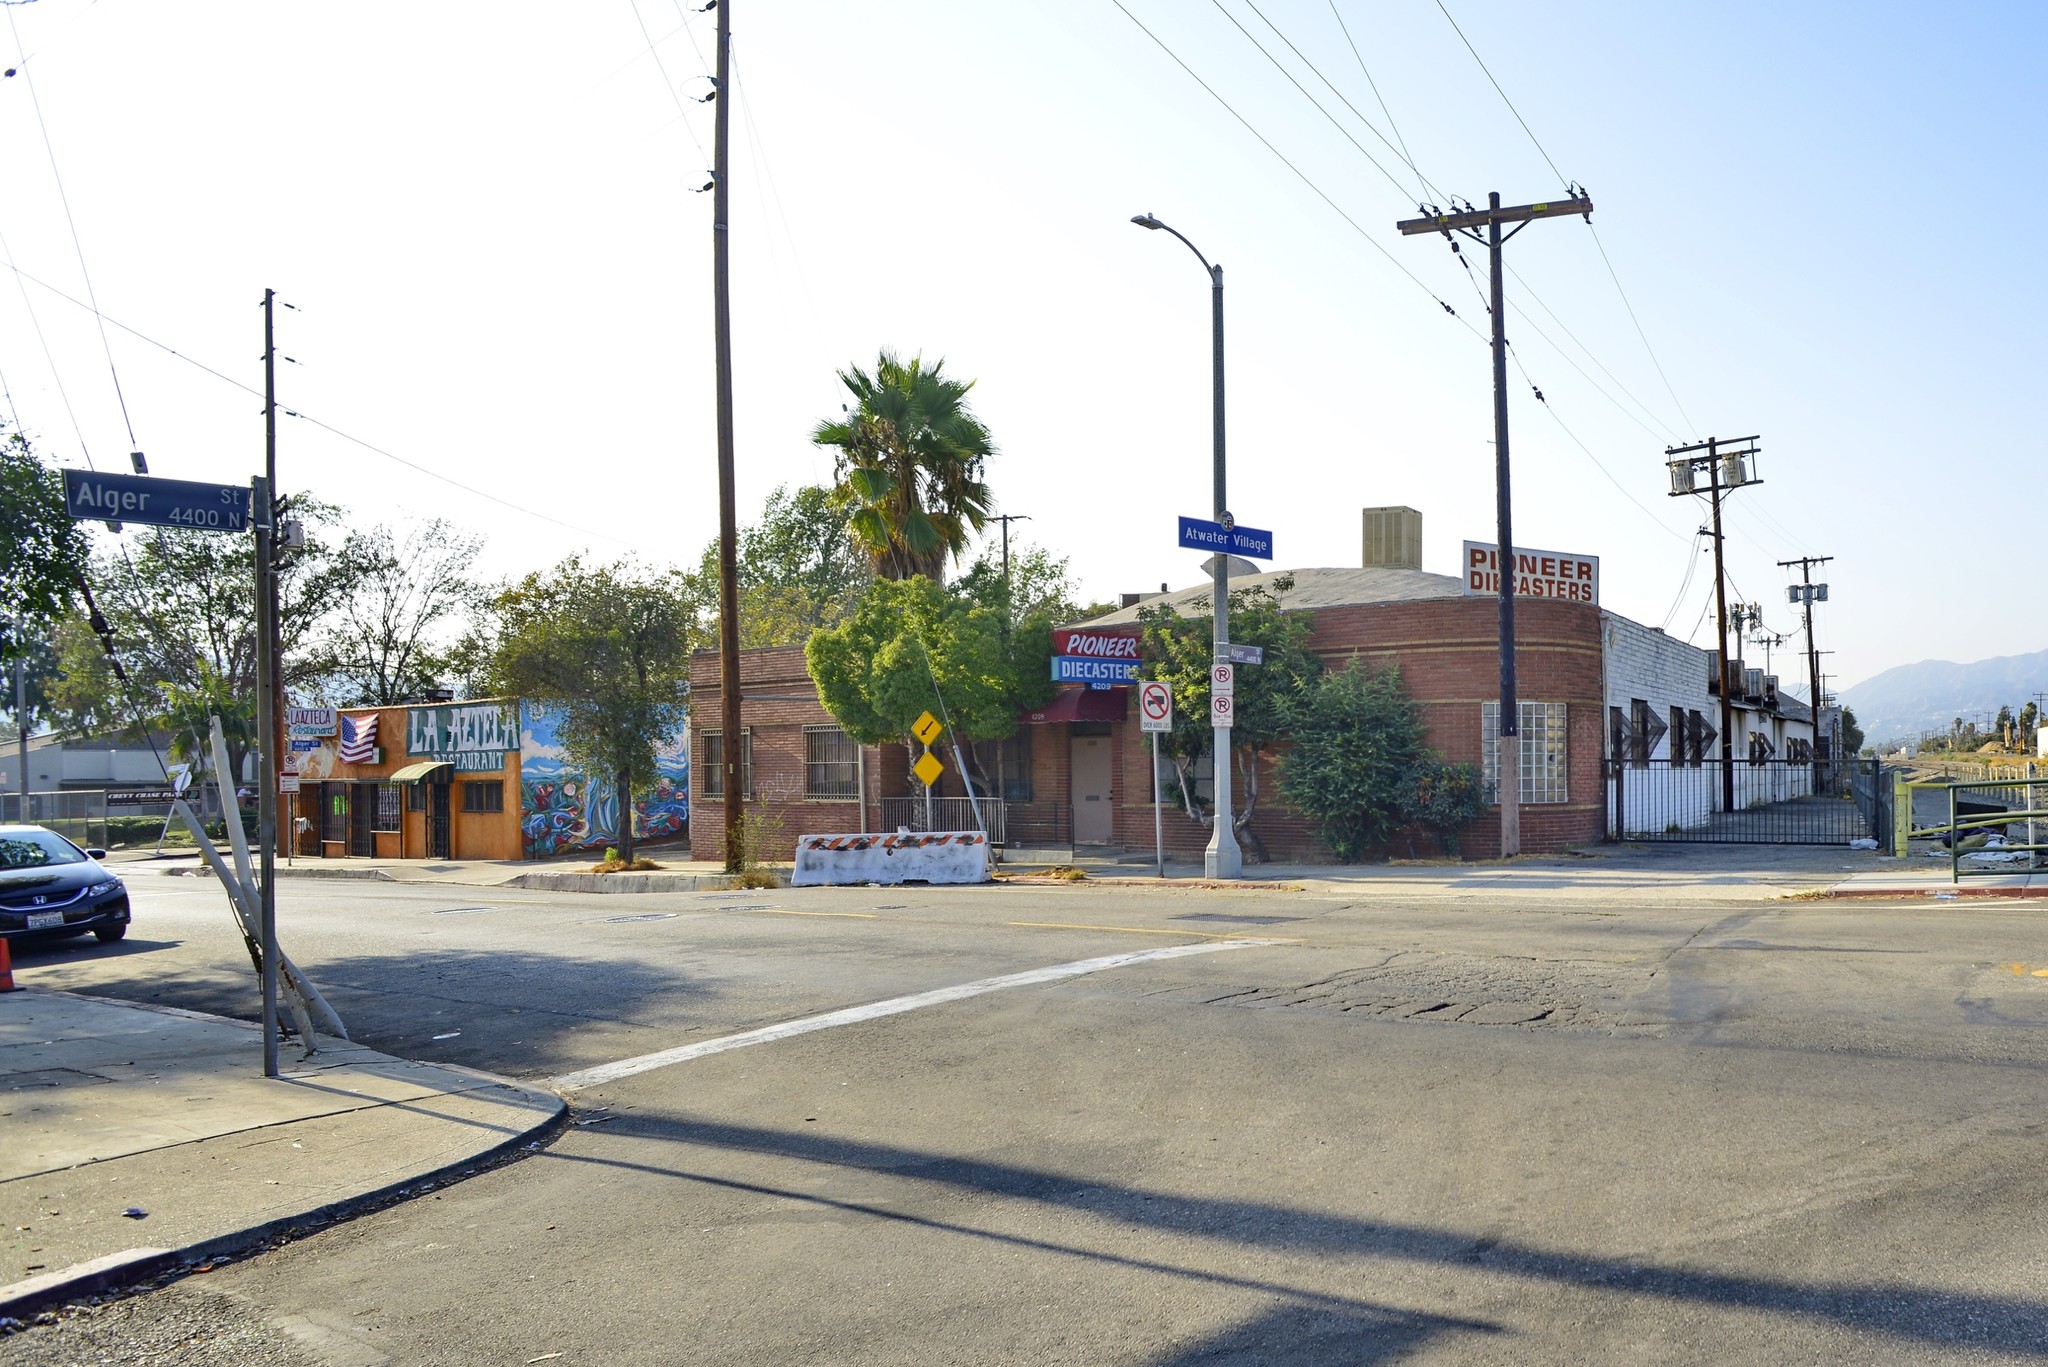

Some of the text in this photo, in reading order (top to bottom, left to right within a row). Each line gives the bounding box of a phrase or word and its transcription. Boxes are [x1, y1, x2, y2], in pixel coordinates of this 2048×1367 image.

[76, 482, 240, 516] Alger St
[168, 507, 240, 528] 4400 N
[1185, 527, 1267, 553] Atwater Village
[1470, 548, 1592, 580] PINEER
[1066, 634, 1137, 657] PIONEER
[1230, 648, 1245, 660] Alger
[300, 710, 331, 724] AZTECA
[409, 705, 519, 753] LA AZTECA
